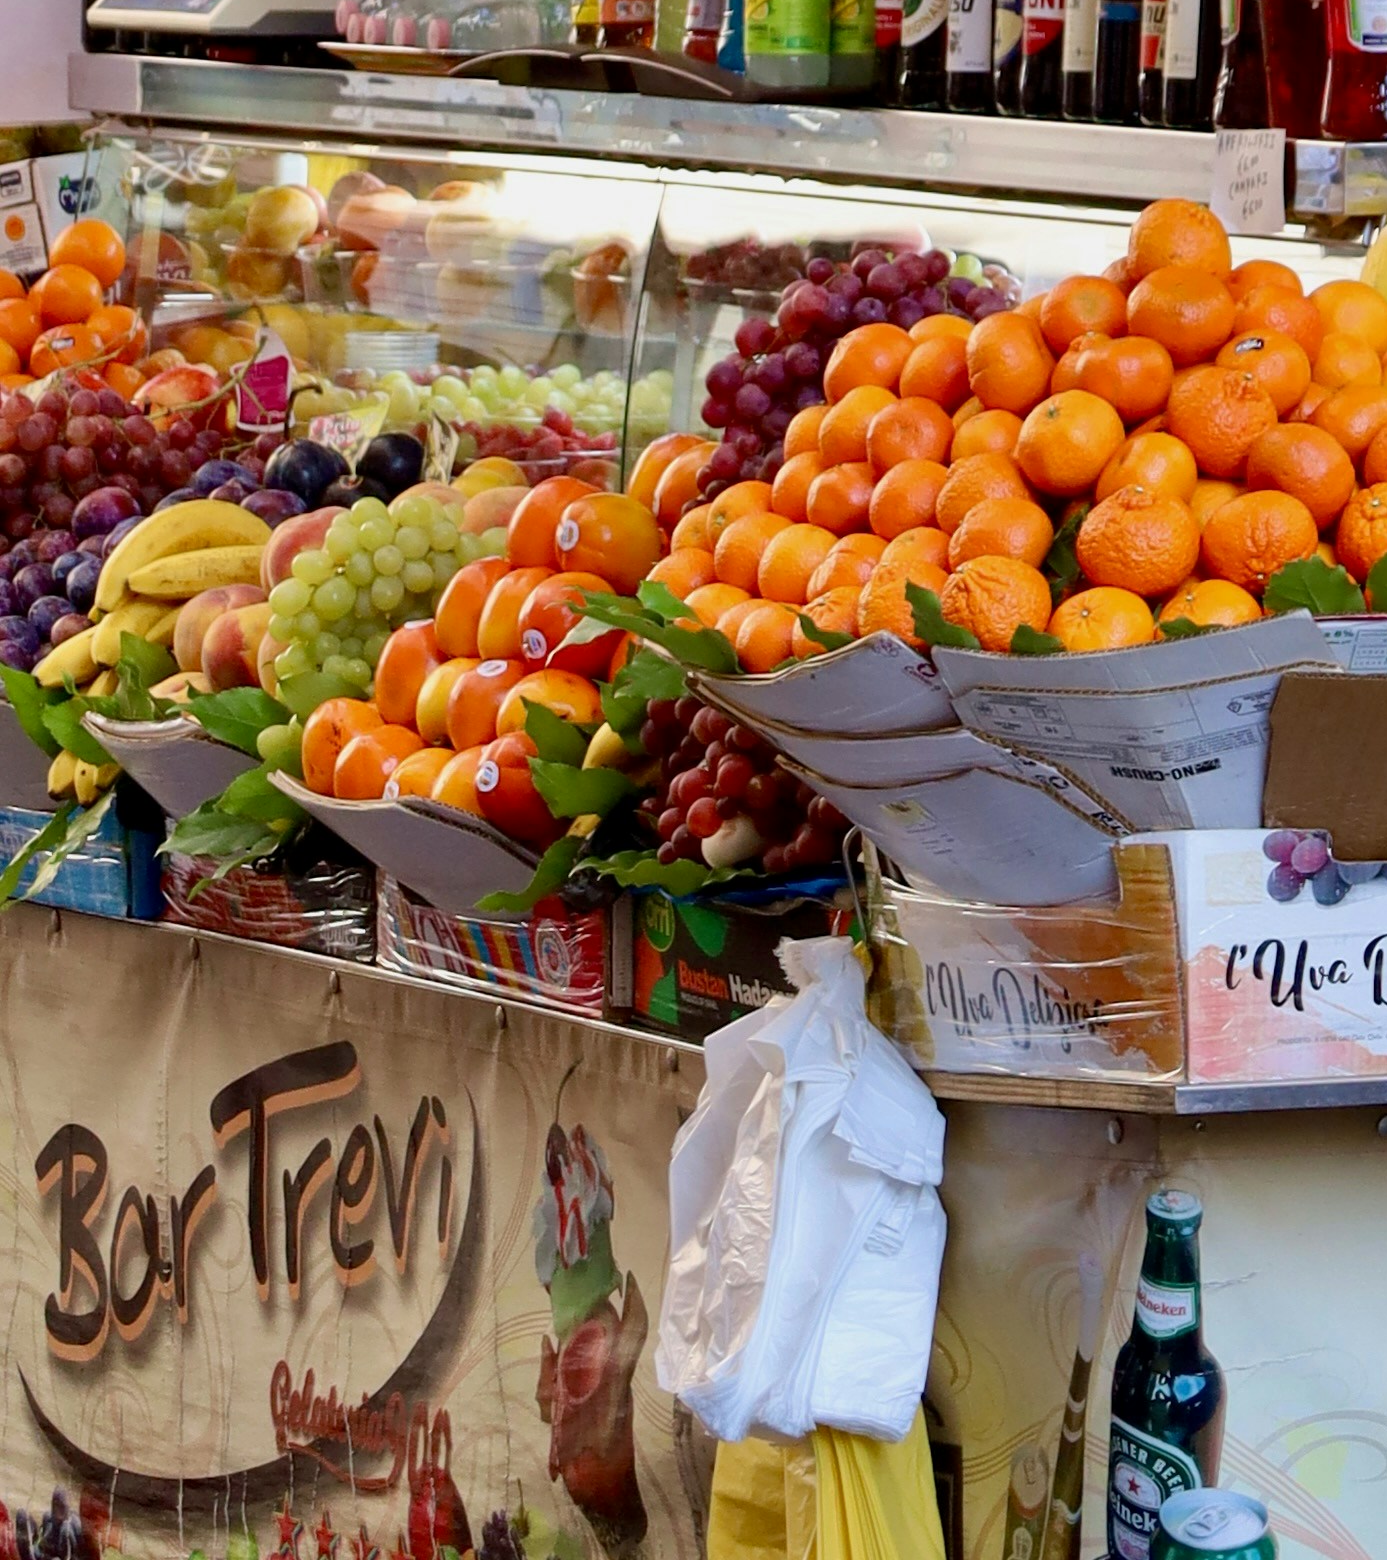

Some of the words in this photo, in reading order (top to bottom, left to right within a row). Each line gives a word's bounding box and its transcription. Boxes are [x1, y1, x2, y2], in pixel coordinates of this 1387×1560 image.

[1110, 764, 1196, 782] NO-CRUSH
[678, 958, 730, 1002] Bustan
[36, 1122, 217, 1362] Bar
[210, 1039, 454, 1303] Trevi
